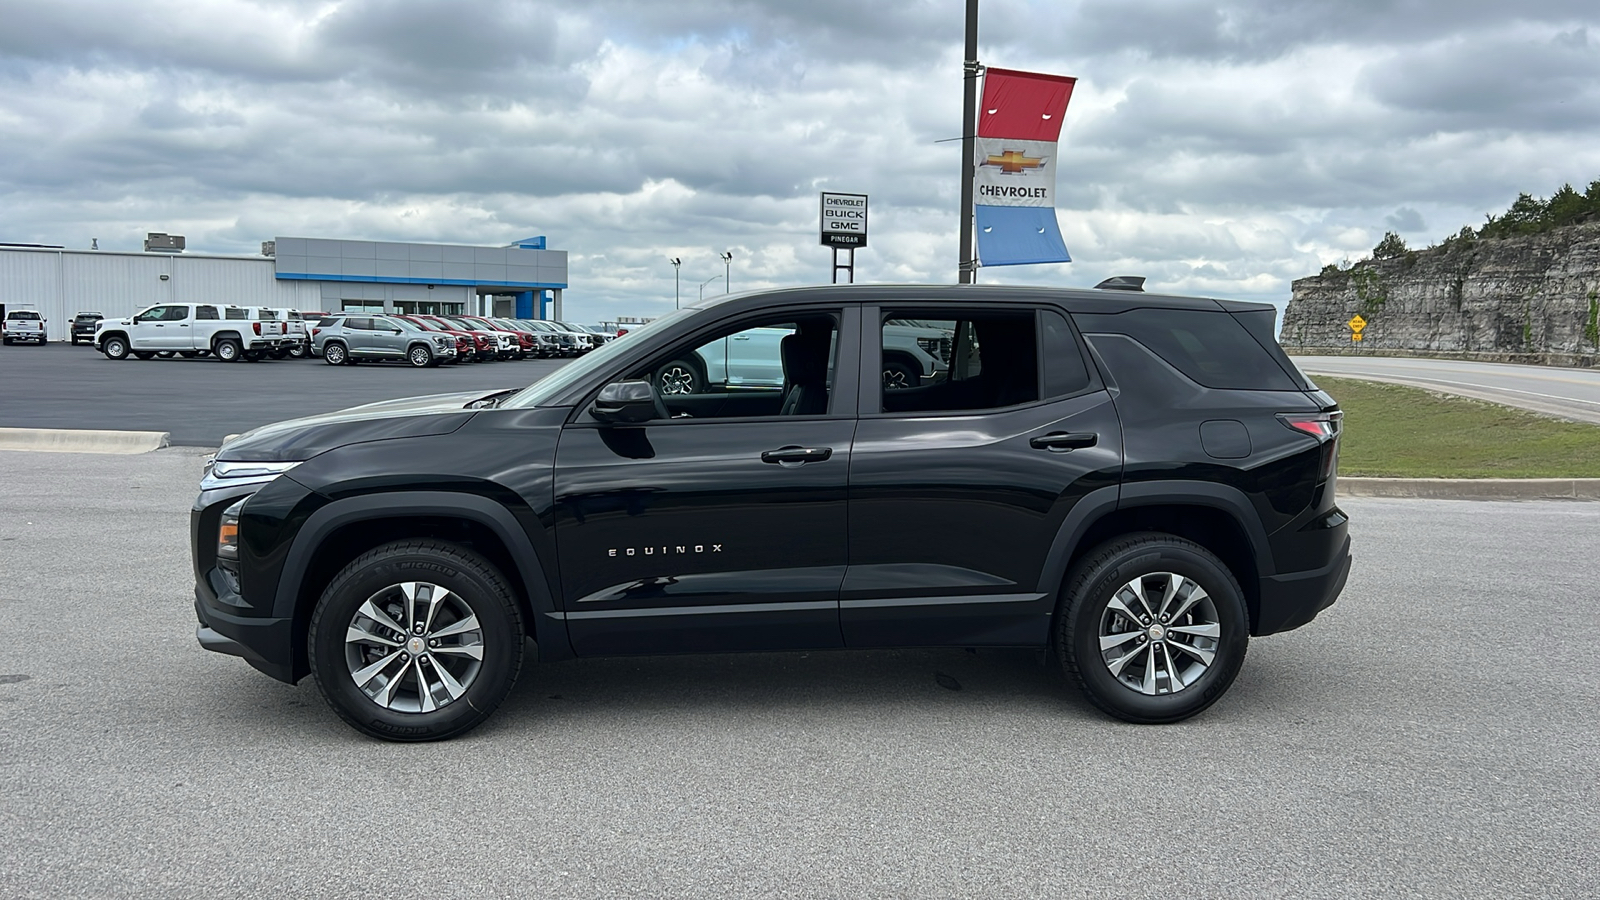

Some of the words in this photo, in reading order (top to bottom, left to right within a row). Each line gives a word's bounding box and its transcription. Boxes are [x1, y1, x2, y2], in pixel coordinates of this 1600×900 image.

[979, 185, 1047, 198] CHEVROLET
[826, 198, 864, 206] CHEVROLET
[825, 210, 864, 218] BUICK
[830, 222, 859, 230] GMC
[830, 235, 859, 243] PINEGAR
[608, 544, 722, 557] EQUINOX
[400, 561, 456, 577] MICHELIN
